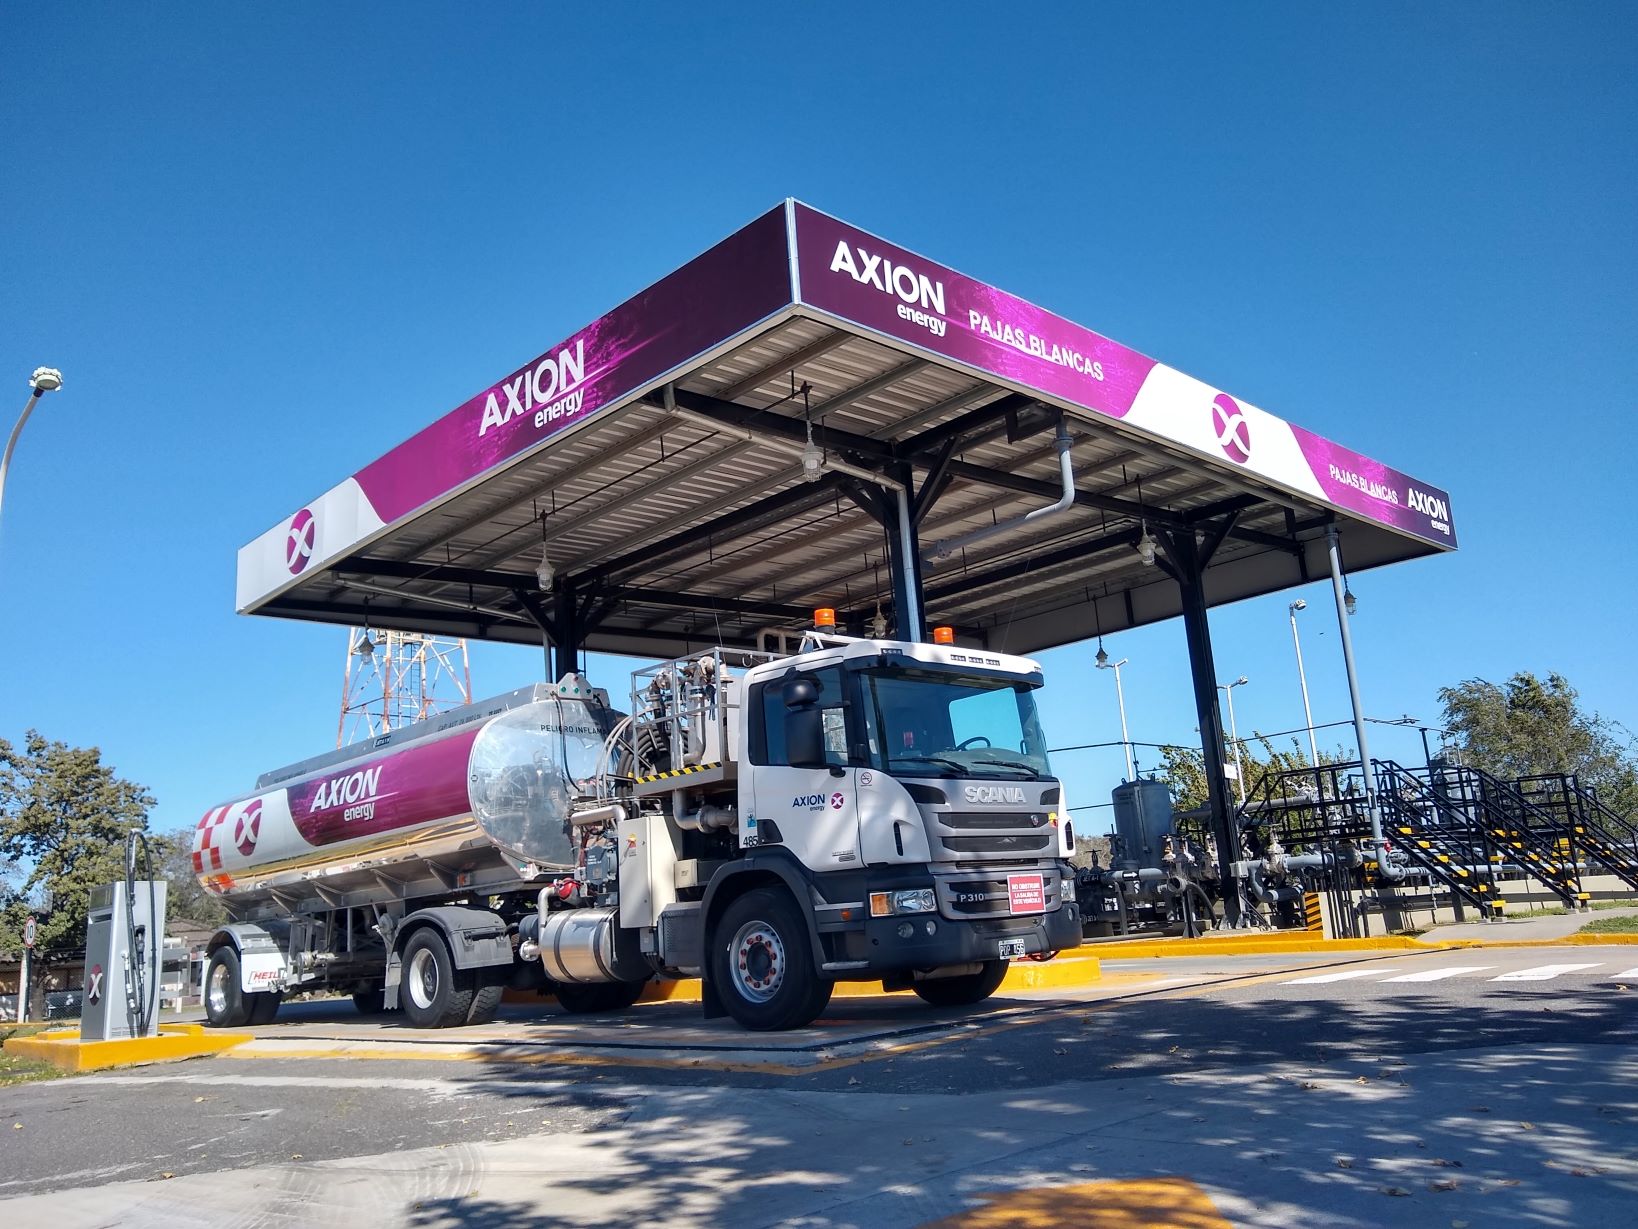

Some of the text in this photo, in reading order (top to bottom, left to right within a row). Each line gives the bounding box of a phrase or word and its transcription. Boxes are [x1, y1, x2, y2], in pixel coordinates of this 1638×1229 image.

[830, 240, 945, 316] AXION
[897, 303, 946, 337] energy
[969, 309, 1104, 381] PAJAS BLANCAS
[478, 339, 585, 437] AXION
[534, 387, 585, 428] energy
[1329, 464, 1399, 505] PAJAS BLANCAS
[1407, 488, 1449, 521] AXION
[1431, 519, 1450, 536] energy
[310, 765, 383, 813] AXION
[792, 794, 826, 808] AXION
[965, 786, 1027, 803] SCANIA
[344, 802, 375, 821] energy
[967, 893, 985, 902] 310
[254, 971, 280, 980] HEIL
